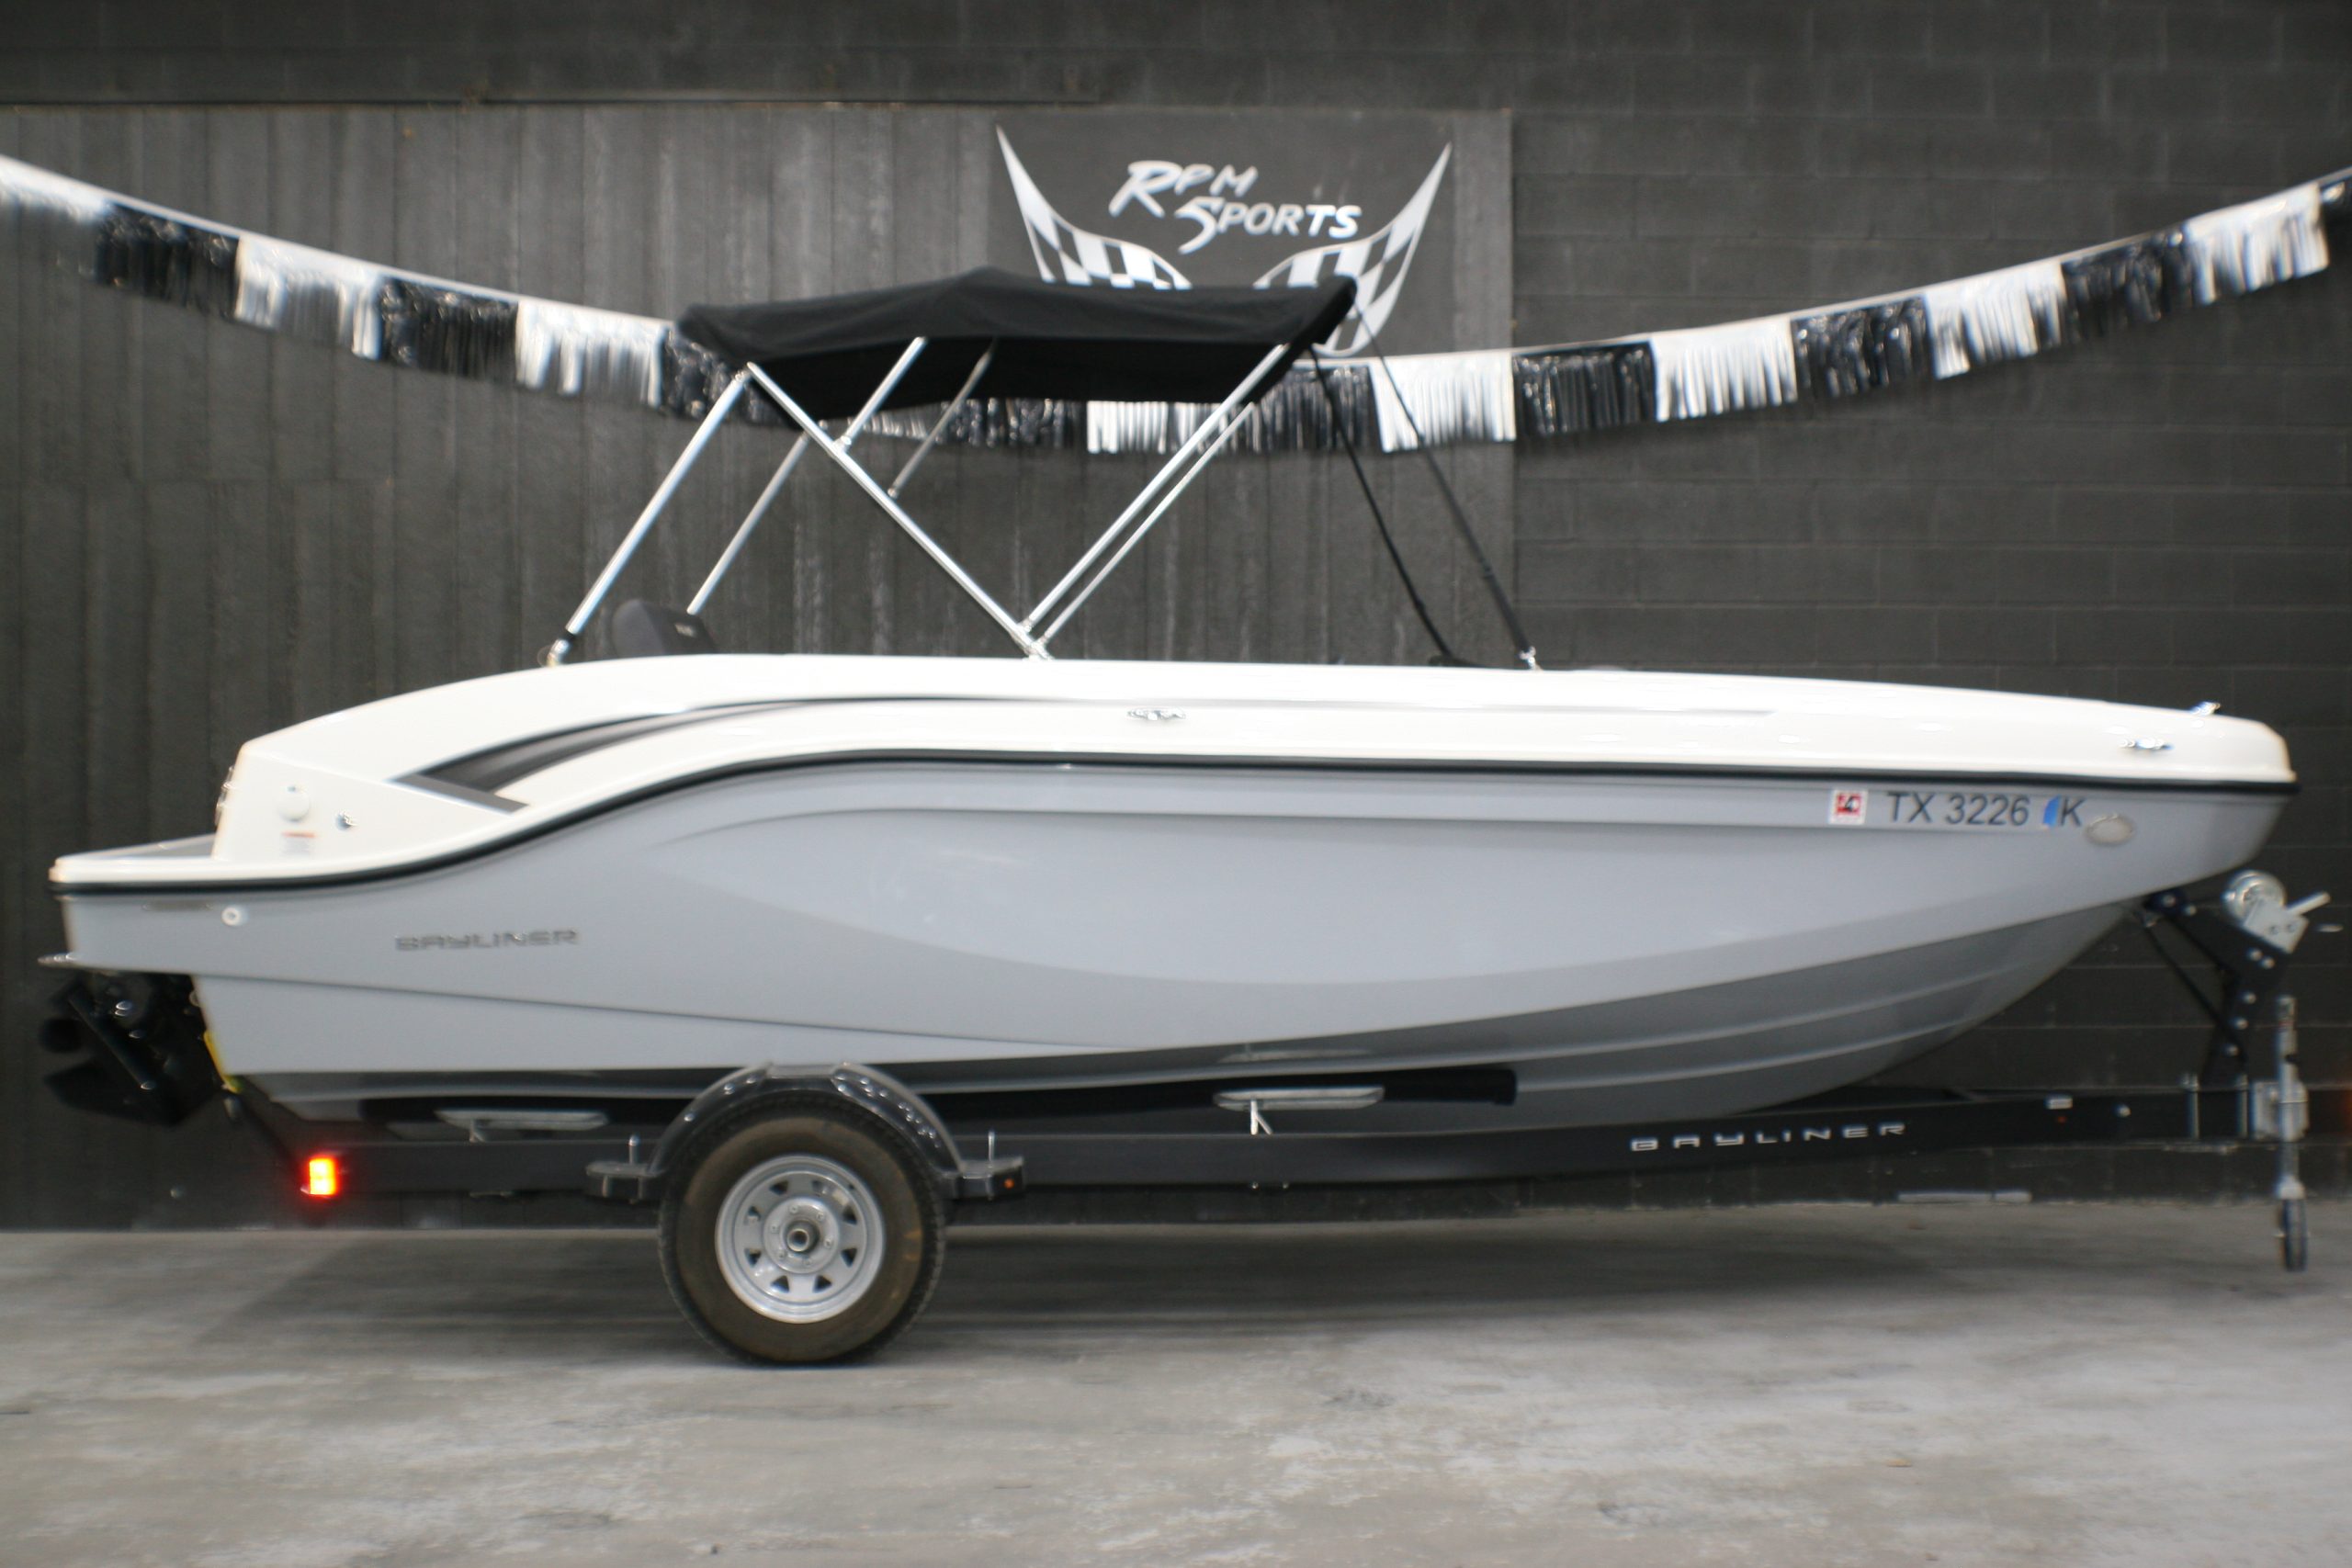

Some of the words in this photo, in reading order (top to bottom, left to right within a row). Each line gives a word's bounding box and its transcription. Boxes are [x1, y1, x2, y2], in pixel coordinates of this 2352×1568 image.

[1108, 159, 1259, 219] RPM
[1174, 197, 1363, 255] SPORTS
[1886, 791, 1936, 825] TX
[1944, 793, 2031, 827] 3226
[2059, 795, 2087, 827] K
[395, 929, 578, 951] BAYLINER
[1630, 1121, 1906, 1152] BAYLINER
